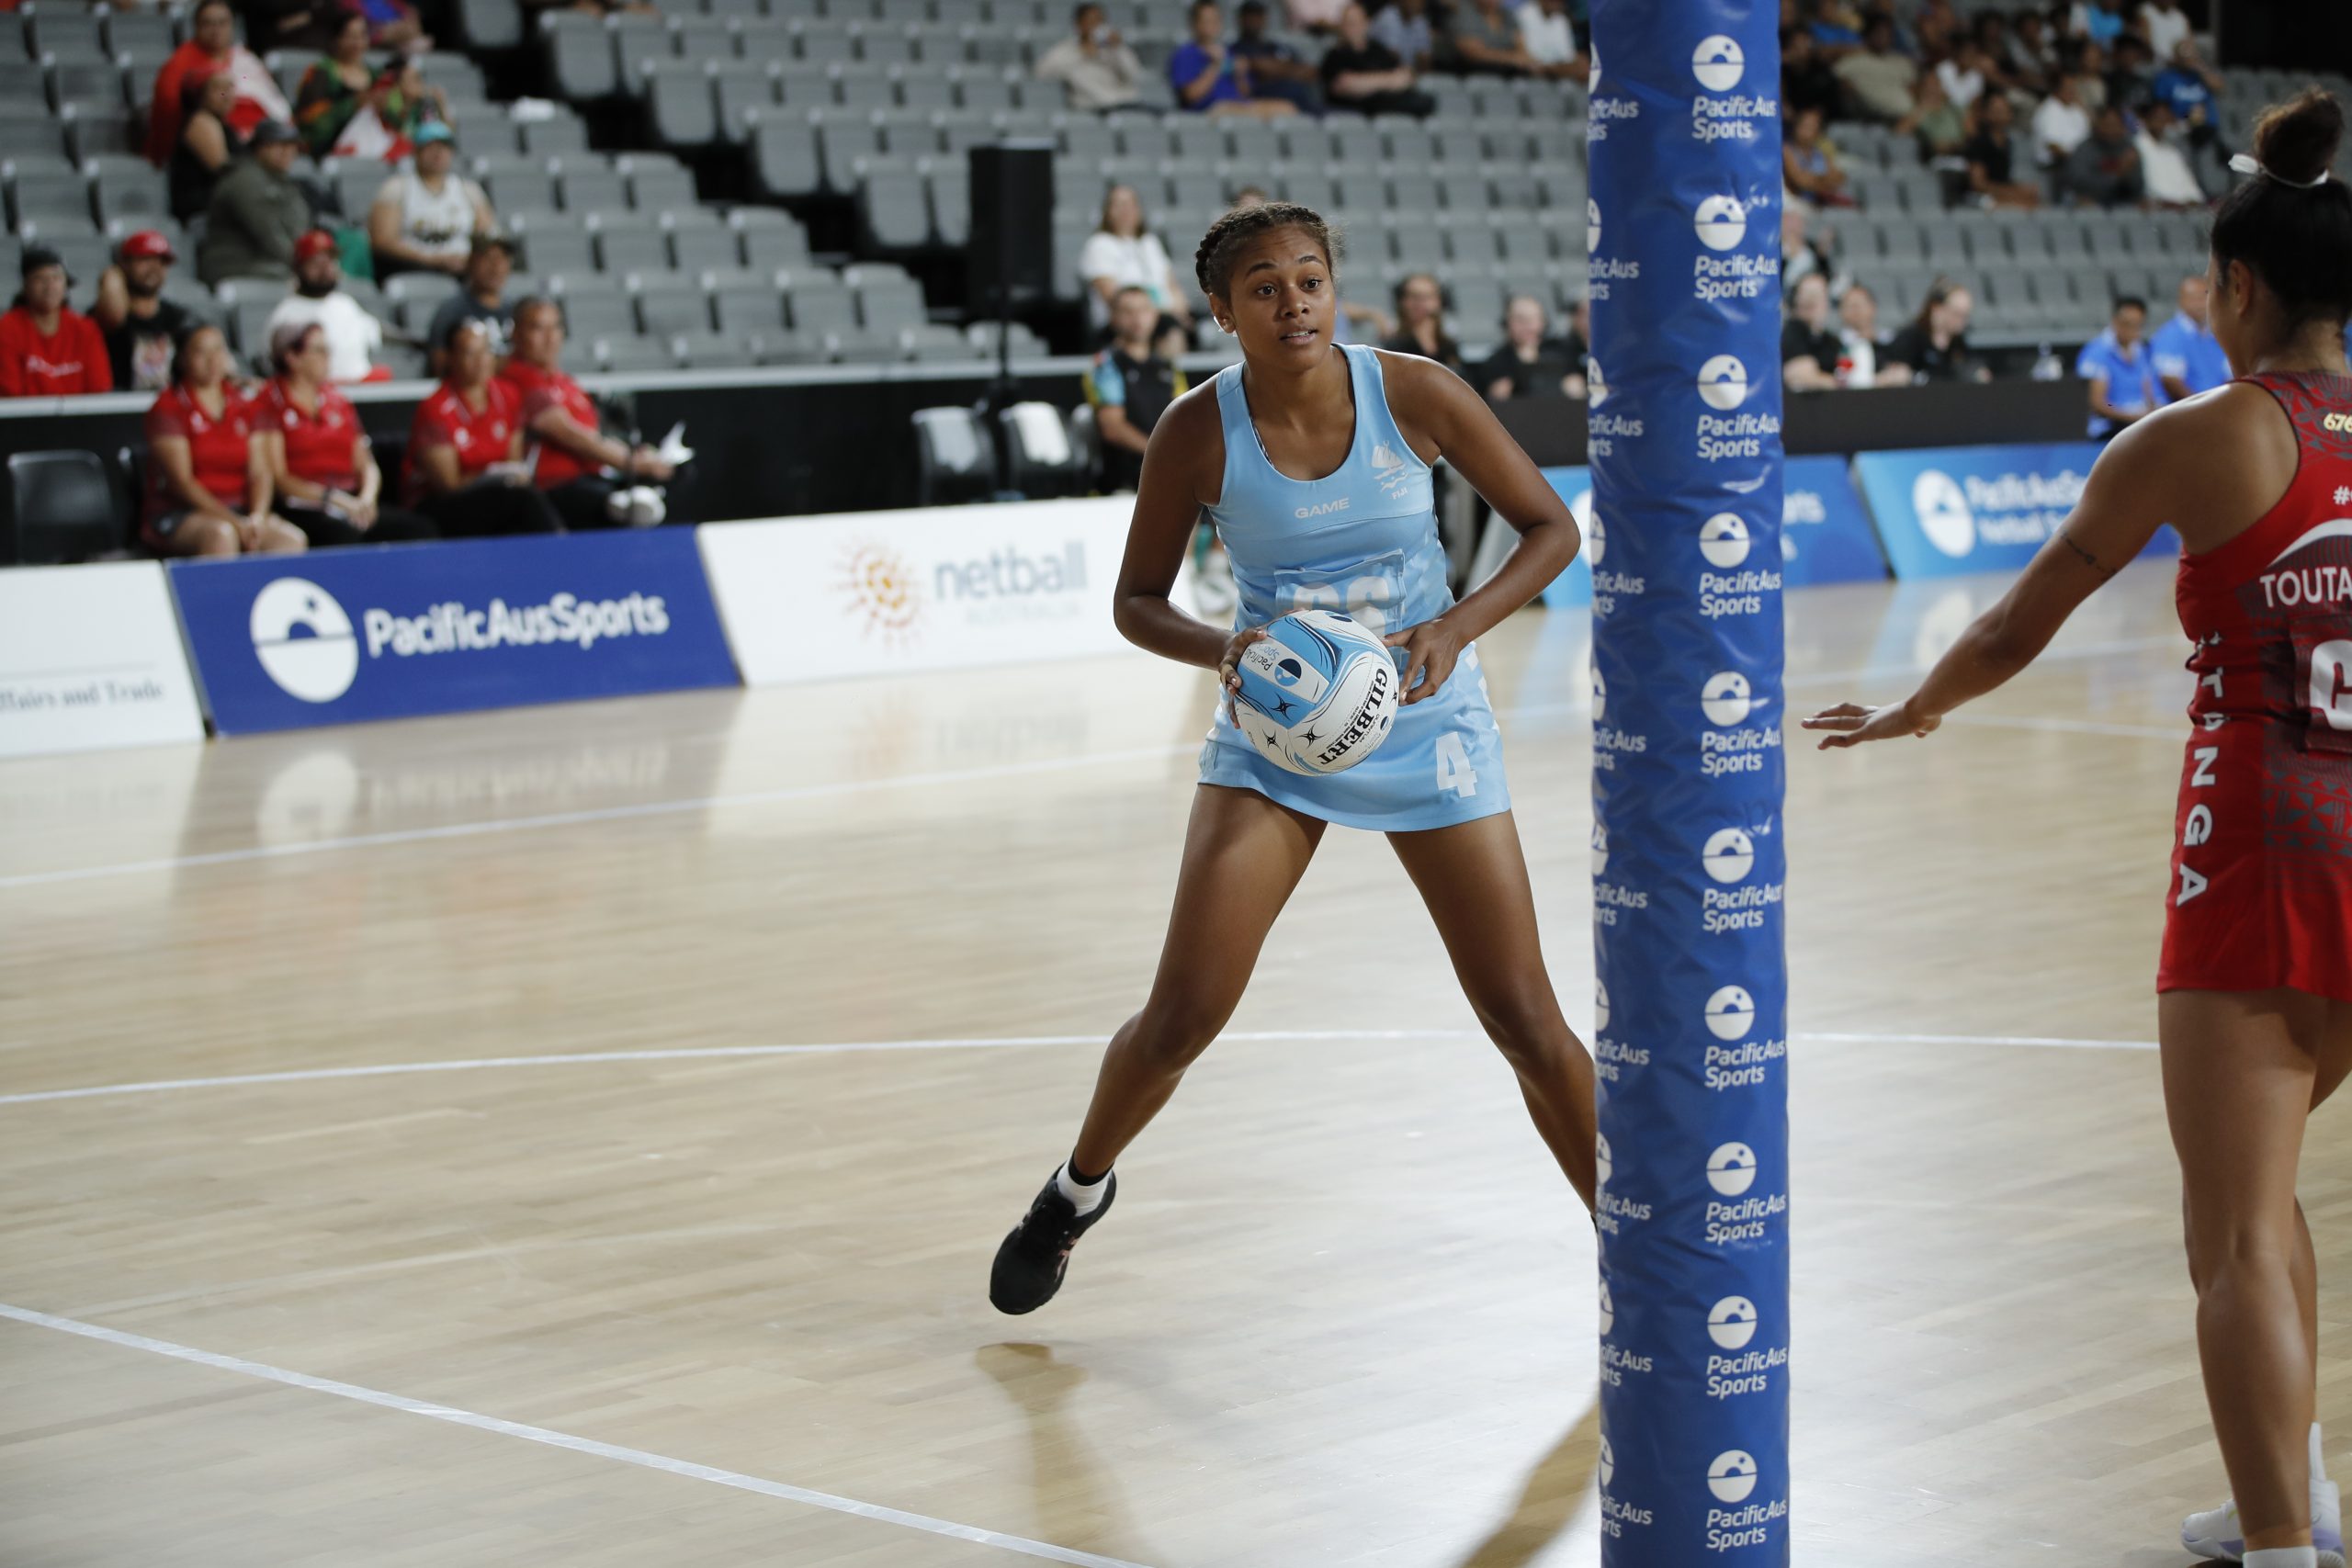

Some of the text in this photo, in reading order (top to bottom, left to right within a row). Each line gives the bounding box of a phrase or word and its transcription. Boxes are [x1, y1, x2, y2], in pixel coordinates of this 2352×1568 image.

[1692, 118, 1754, 143] Sports
[1694, 277, 1758, 303] Sports
[1697, 436, 1759, 463] Sports
[1391, 487, 1408, 501] FIJI
[1295, 497, 1351, 519] GAME
[933, 541, 1089, 603] netball
[1699, 594, 1761, 620] Sports
[363, 591, 670, 659] PacificAusSports
[1317, 668, 1387, 765] GILBERT
[1436, 731, 1478, 798] 4
[1701, 751, 1763, 778] Sports
[1702, 908, 1764, 935] Sports
[1704, 1039, 1785, 1066] PacificAus
[1704, 1066, 1765, 1091] Sports
[1705, 1194, 1786, 1222] PacificAus
[1705, 1221, 1765, 1246] Sports
[1706, 1347, 1788, 1375] PacificAus
[1706, 1374, 1767, 1400] Sports
[1706, 1499, 1787, 1529] PacificAus
[1706, 1527, 1766, 1552] Sports
